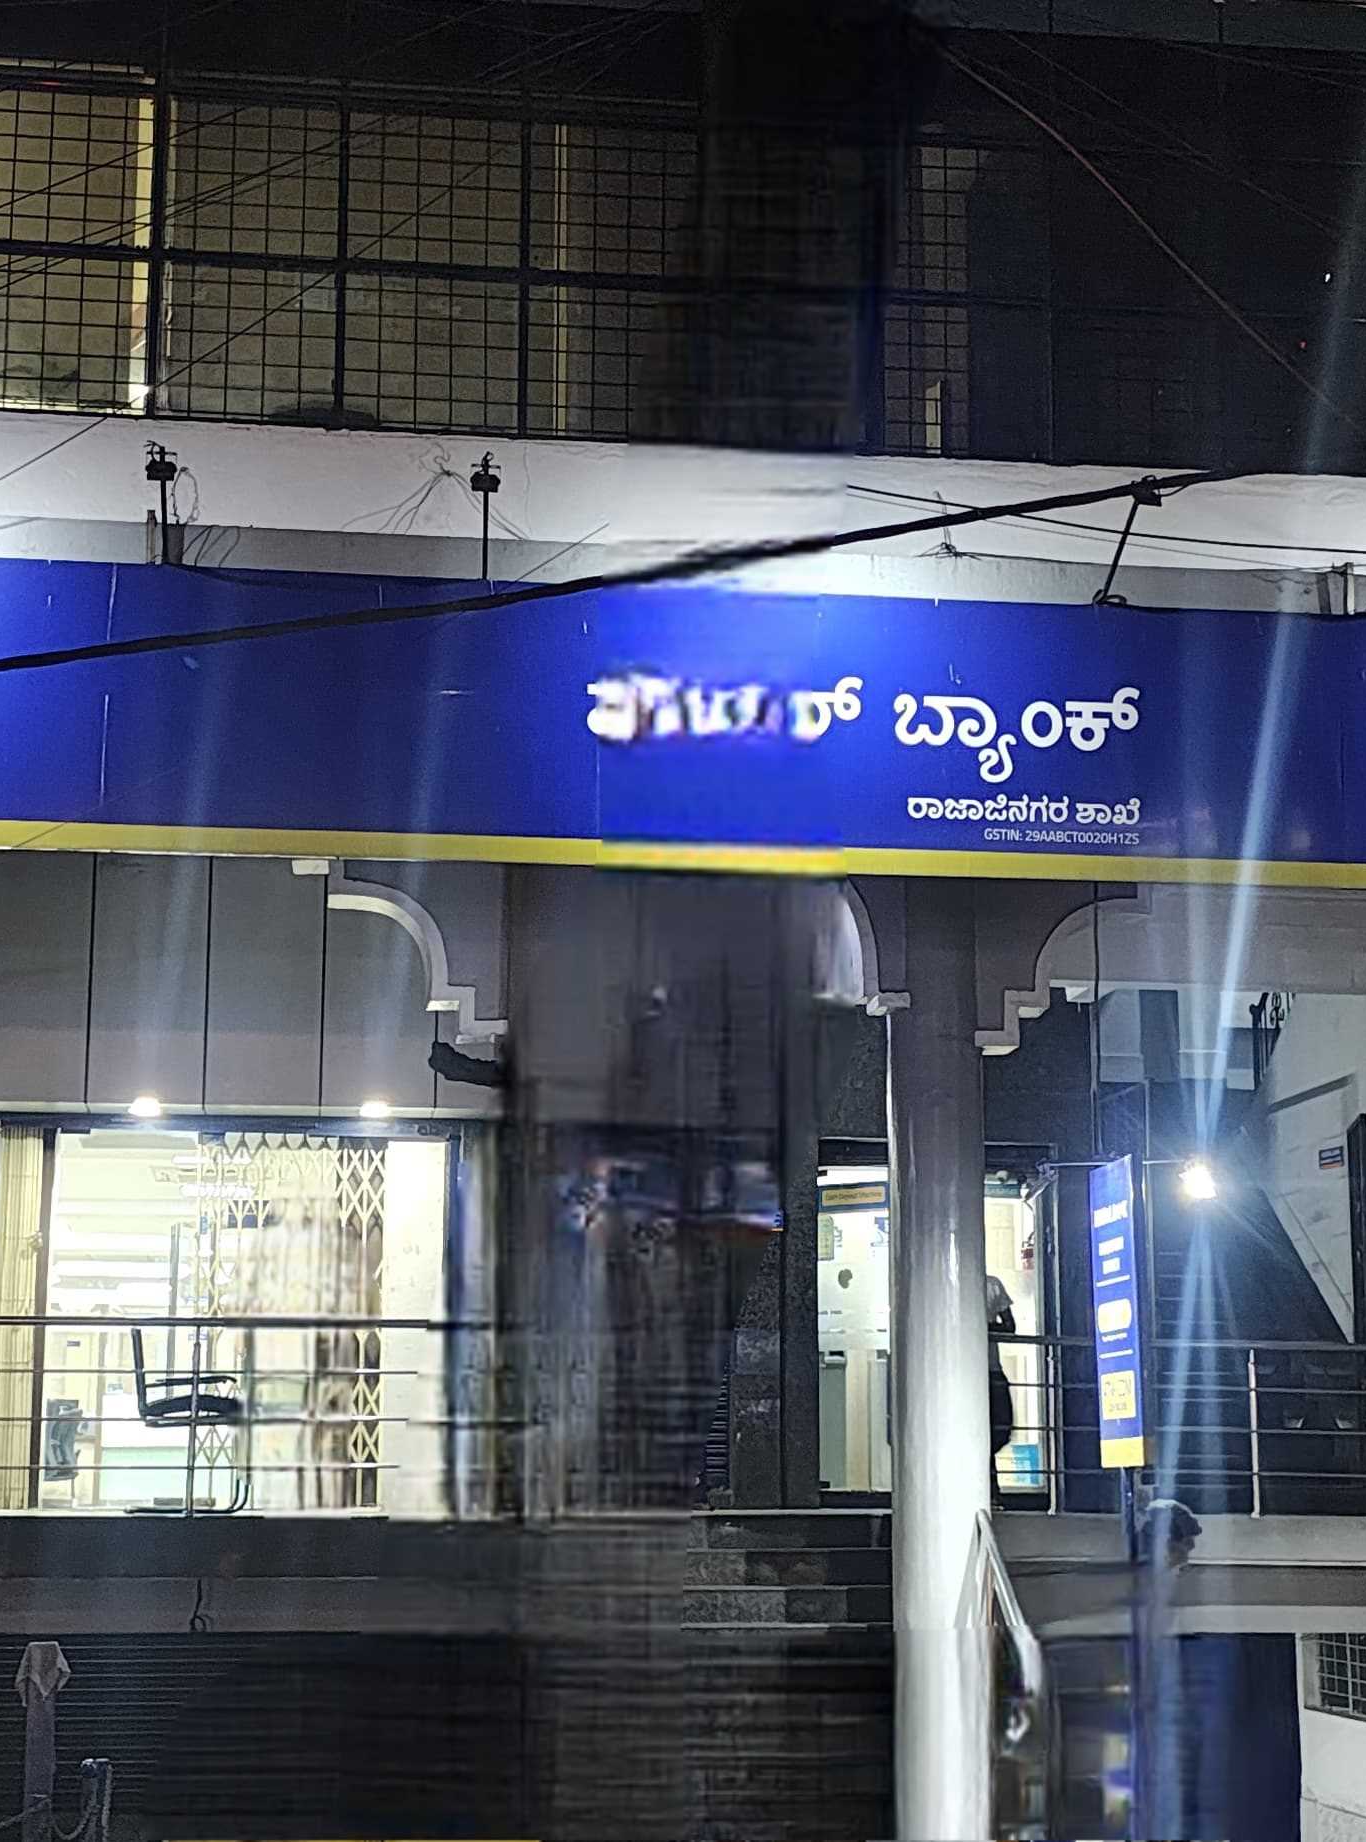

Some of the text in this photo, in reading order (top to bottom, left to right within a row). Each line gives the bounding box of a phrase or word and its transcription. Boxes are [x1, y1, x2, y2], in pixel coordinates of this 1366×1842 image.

[893, 686, 1140, 783] ಬ್ಯಾಂಕ್
[907, 794, 1141, 825] ರಾಜಾಜಿನಗರ ಶಾಖೆ
[984, 828, 1023, 841] GSTIN:
